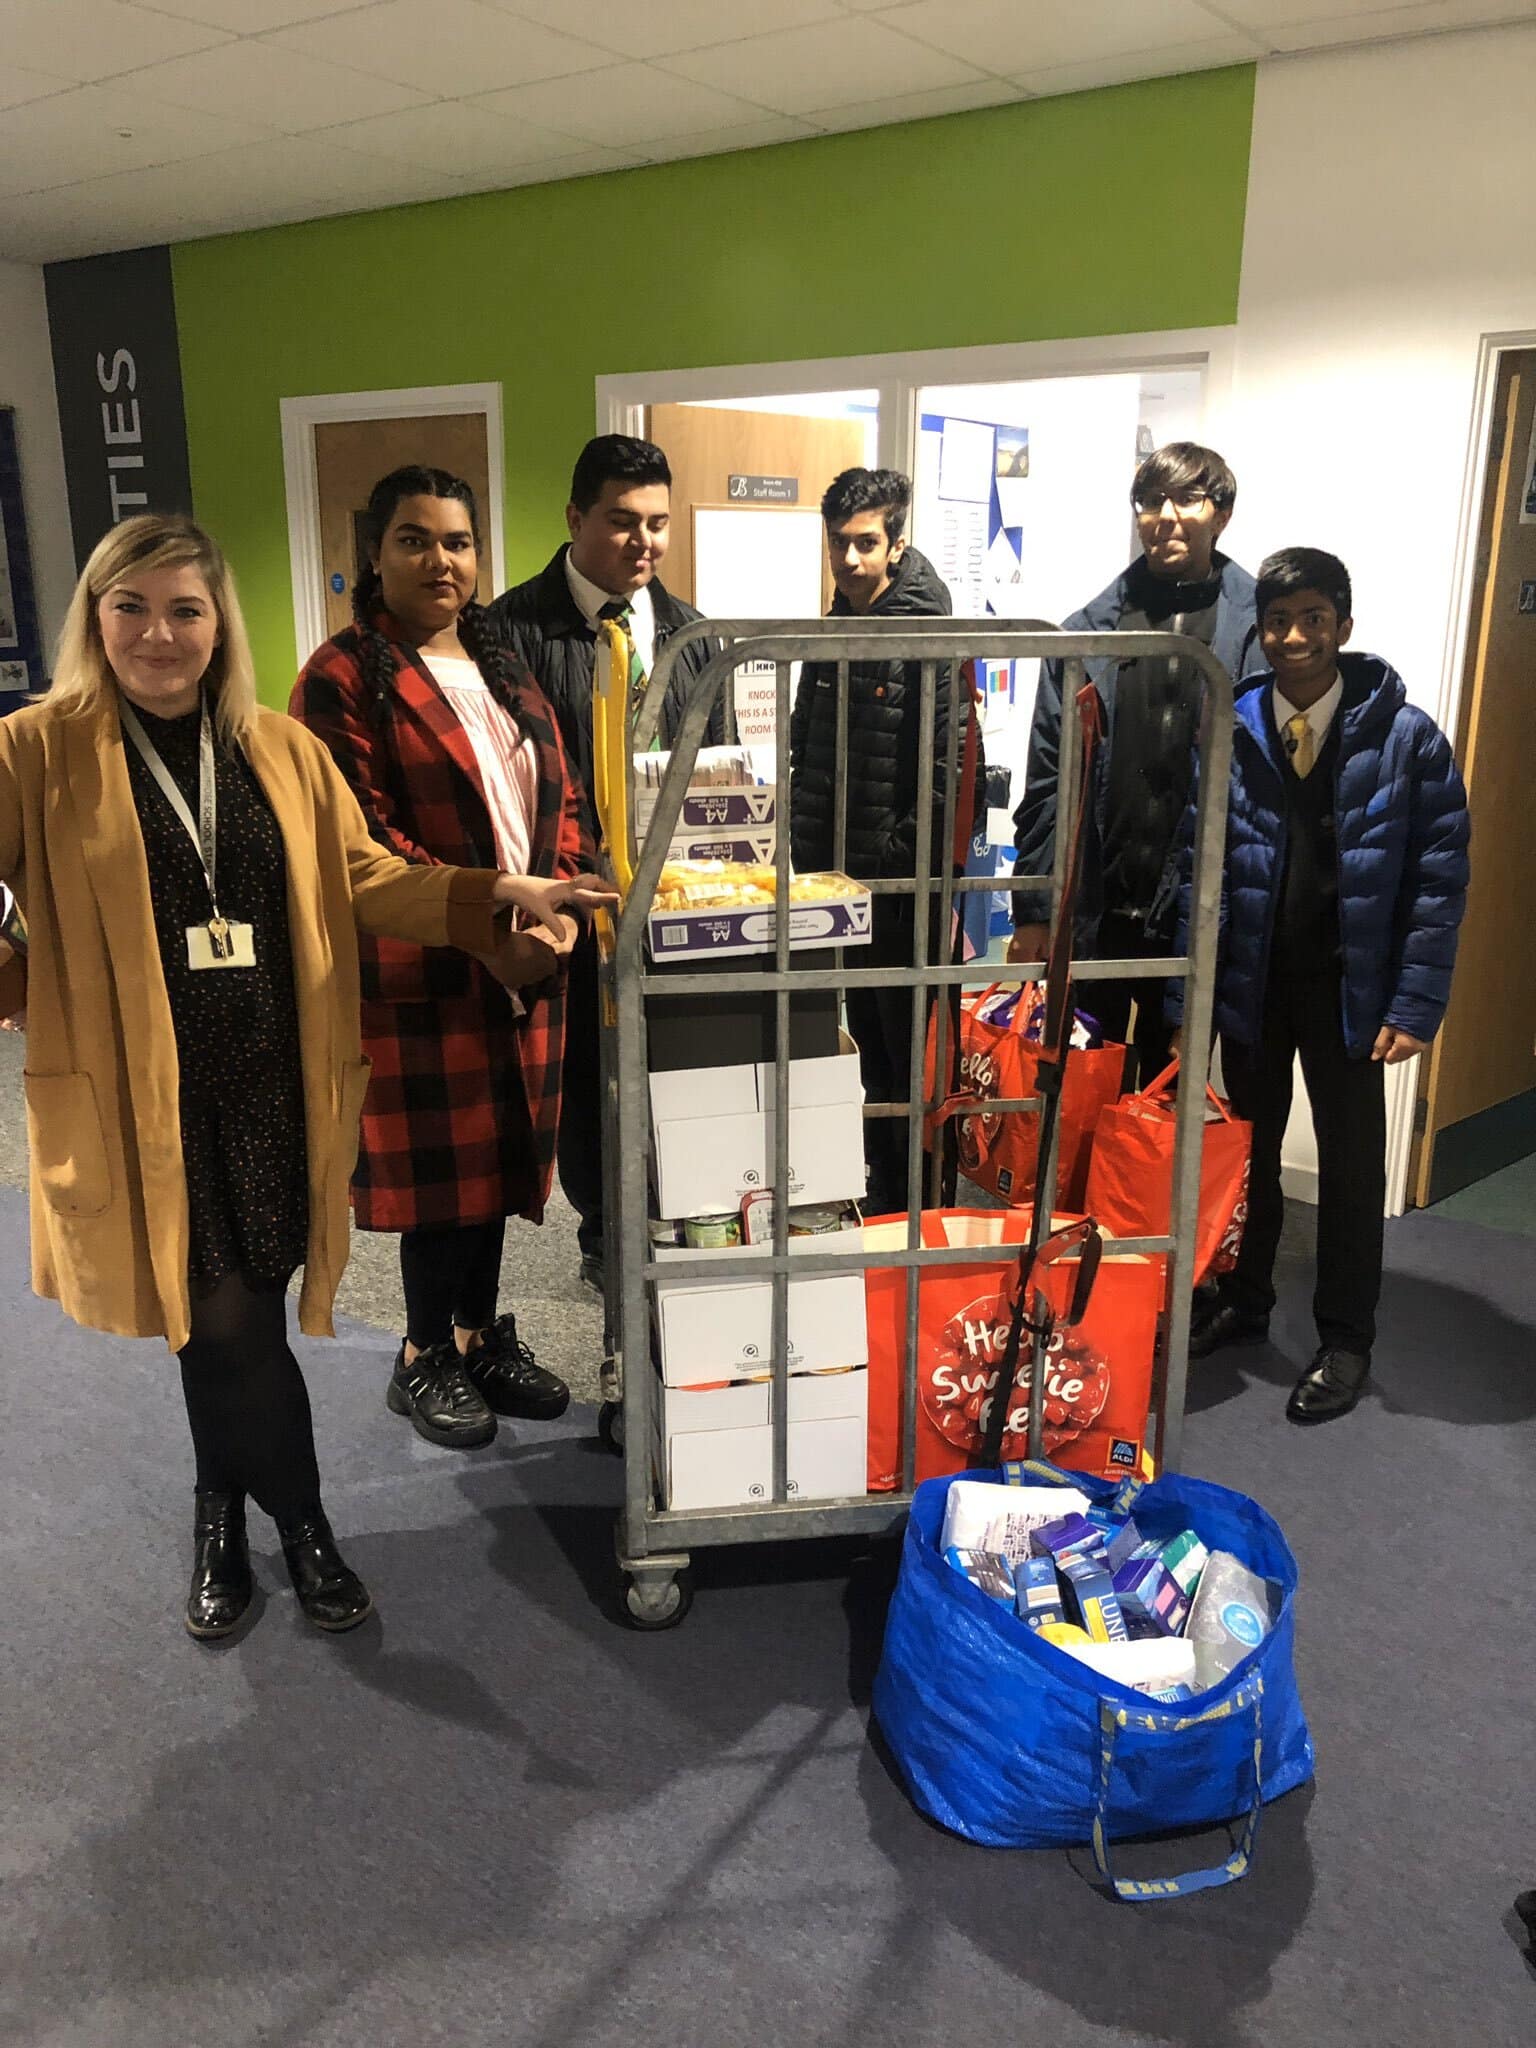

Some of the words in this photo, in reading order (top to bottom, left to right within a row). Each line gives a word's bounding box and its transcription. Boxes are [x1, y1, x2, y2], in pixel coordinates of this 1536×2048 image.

[97, 347, 148, 523] TIES
[753, 488, 767, 496] Staff
[768, 488, 786, 497] Room
[748, 690, 776, 700] KNOCK
[753, 708, 760, 717] IS
[762, 708, 768, 717] A
[745, 725, 771, 734] ROOM
[705, 809, 728, 823] A4
[712, 929, 730, 942] A4
[960, 1053, 992, 1086] ello
[932, 1355, 1083, 1402] Swetie
[1112, 1454, 1133, 1463] ALDI
